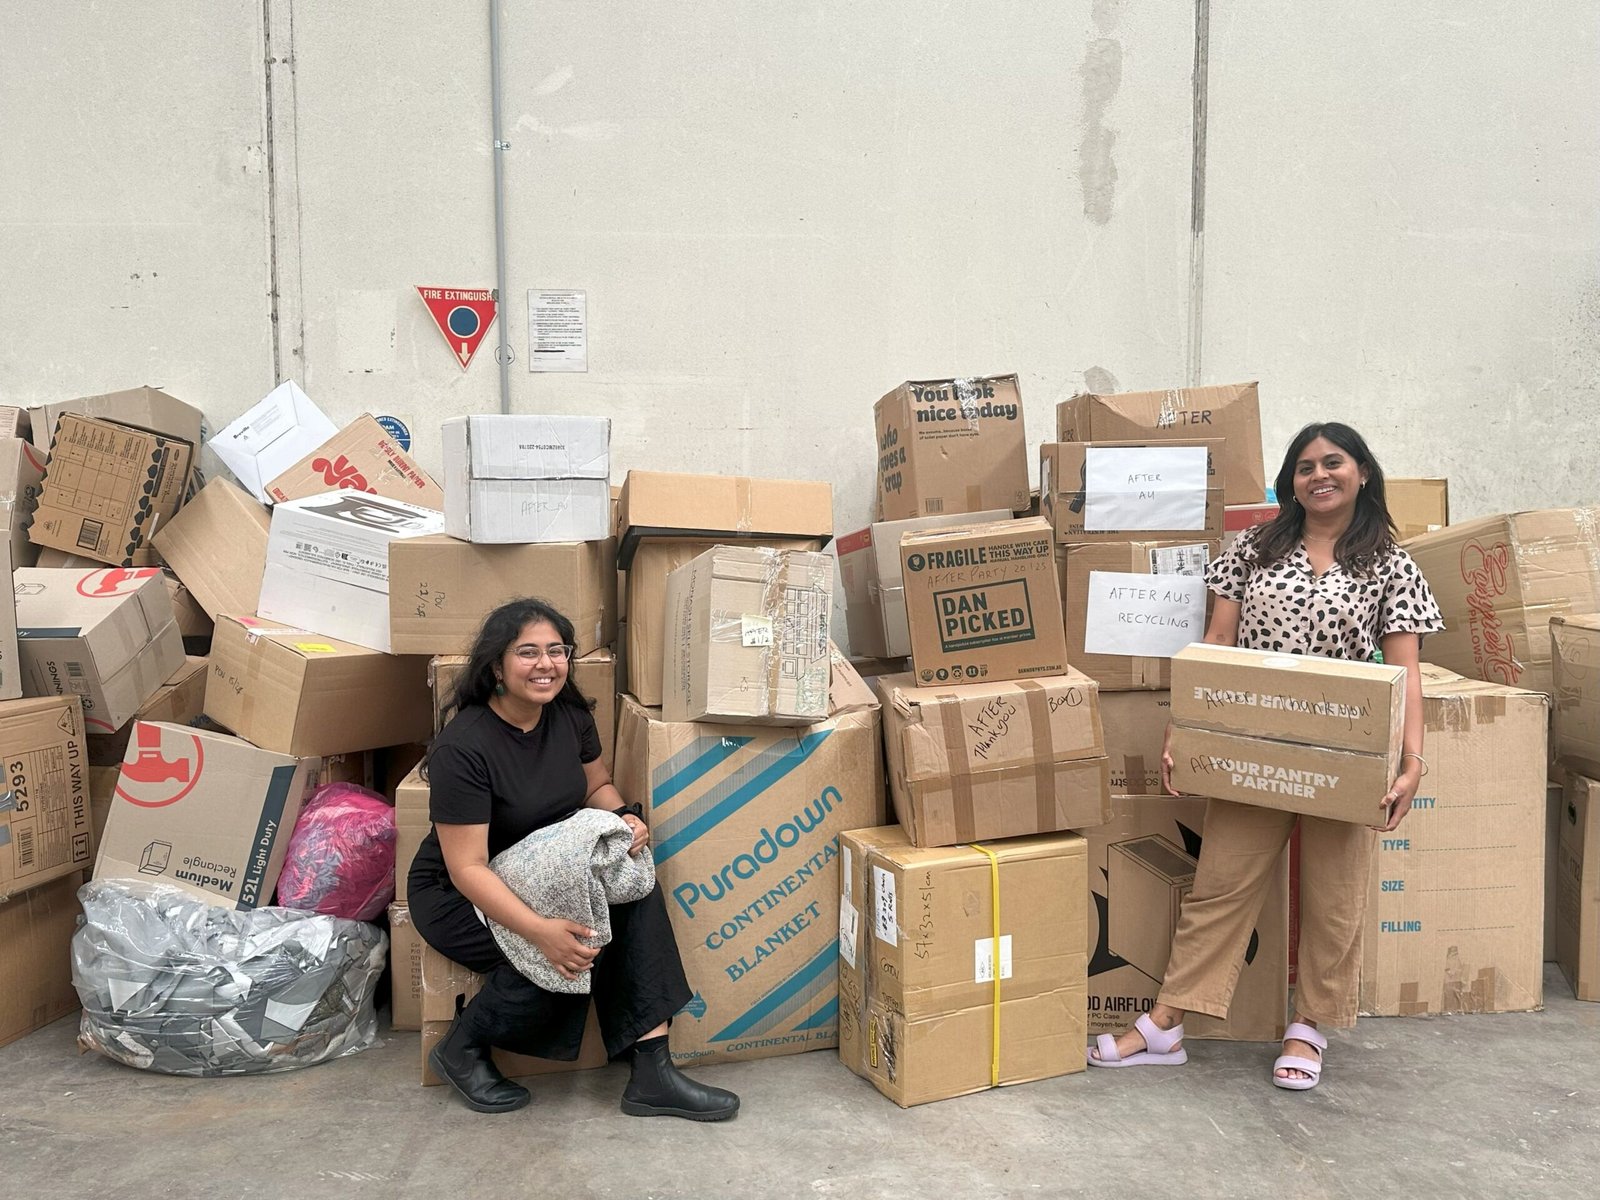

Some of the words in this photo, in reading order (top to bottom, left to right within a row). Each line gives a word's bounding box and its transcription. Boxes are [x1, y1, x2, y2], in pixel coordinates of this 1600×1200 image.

[423, 289, 442, 300] FIRE
[445, 290, 494, 302] EXTINGUISH
[912, 387, 949, 403] You
[952, 382, 995, 401] lok
[916, 405, 957, 423] nice
[880, 423, 898, 452] who
[407, 471, 426, 489] PAPER
[884, 470, 903, 495] crap
[1127, 473, 1162, 485] AFTER
[988, 543, 1014, 551] HANDLE
[989, 549, 1011, 559] THIS
[1013, 547, 1035, 556] WAY
[1036, 545, 1049, 554] UP
[927, 546, 987, 570] FRAGILE
[927, 572, 966, 589] AFTER
[942, 591, 987, 616] DAN
[1109, 586, 1157, 601] AFTER
[1162, 591, 1191, 605] AUS
[945, 607, 1025, 638] PICKED
[1118, 611, 1189, 629] RECYCLING
[1467, 609, 1484, 665] PILLOWS
[46, 659, 65, 696] NNINGS
[1206, 689, 1250, 710] After
[968, 695, 1006, 738] AFTER
[67, 740, 79, 759] UP
[1190, 754, 1231, 775] After
[1209, 756, 1260, 776] YOUR
[1263, 765, 1340, 789] PANTRY
[10, 760, 30, 812] 5293
[69, 759, 83, 795] WAY
[1231, 773, 1316, 799] PARTNER
[74, 796, 85, 828] THIS
[672, 785, 843, 919] Puradown
[1382, 839, 1410, 851] TYPE
[183, 856, 237, 878] Rectangle
[242, 868, 261, 904] 52L
[252, 838, 268, 874] Light
[262, 819, 278, 846] Duty
[175, 869, 234, 892] Medium
[1381, 880, 1405, 892] SIZE
[1381, 920, 1422, 933] FILLING
[724, 900, 822, 984] BLANKET
[1090, 1021, 1129, 1030] moyen-tour
[725, 1032, 812, 1052] CONTINENTAL
